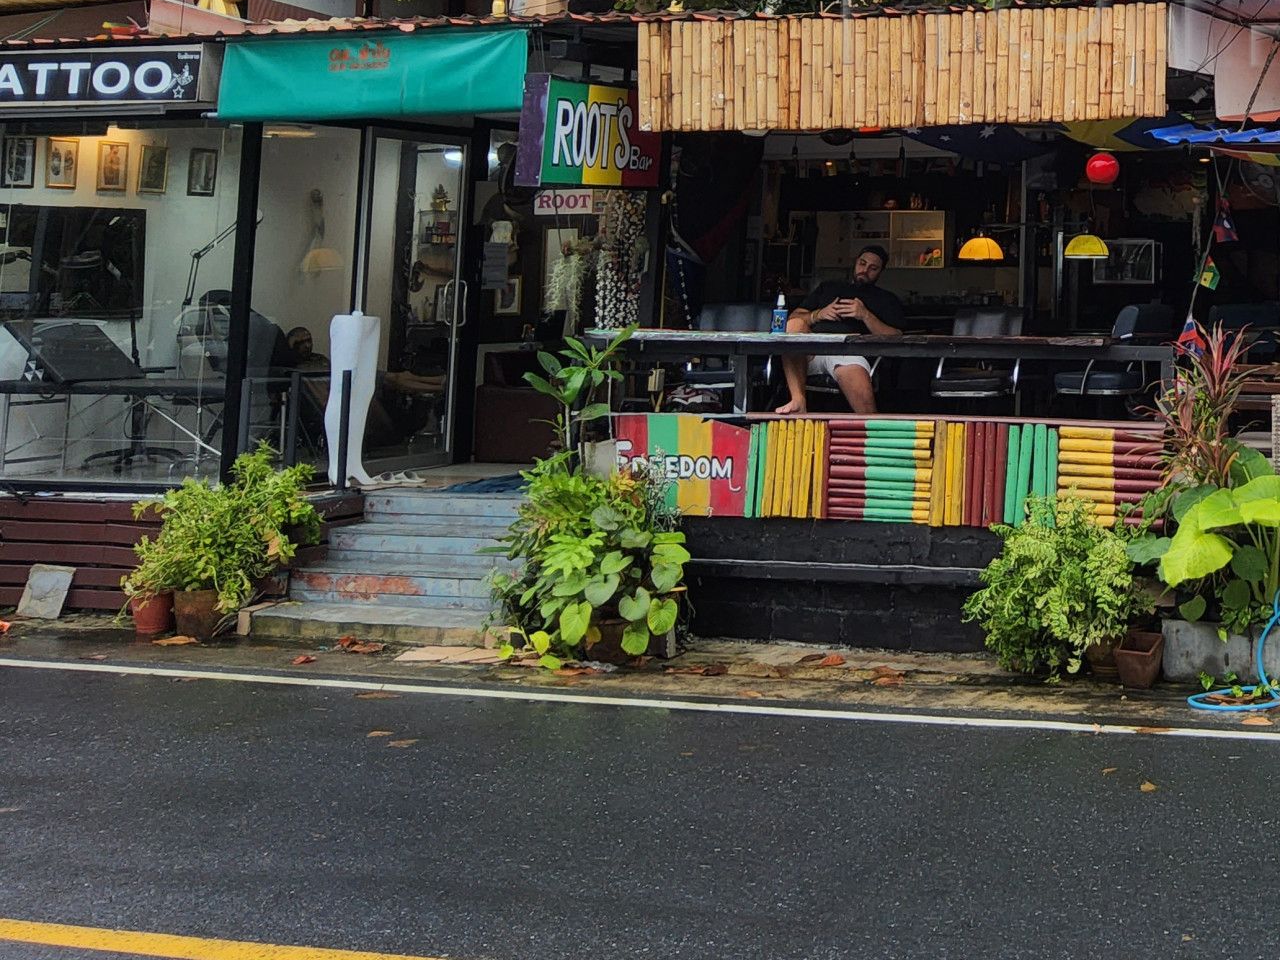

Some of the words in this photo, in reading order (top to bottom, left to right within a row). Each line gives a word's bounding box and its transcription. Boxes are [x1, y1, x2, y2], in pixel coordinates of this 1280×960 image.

[551, 97, 634, 170] ROOT'S
[628, 145, 653, 172] Bar
[538, 193, 591, 209] ROOT
